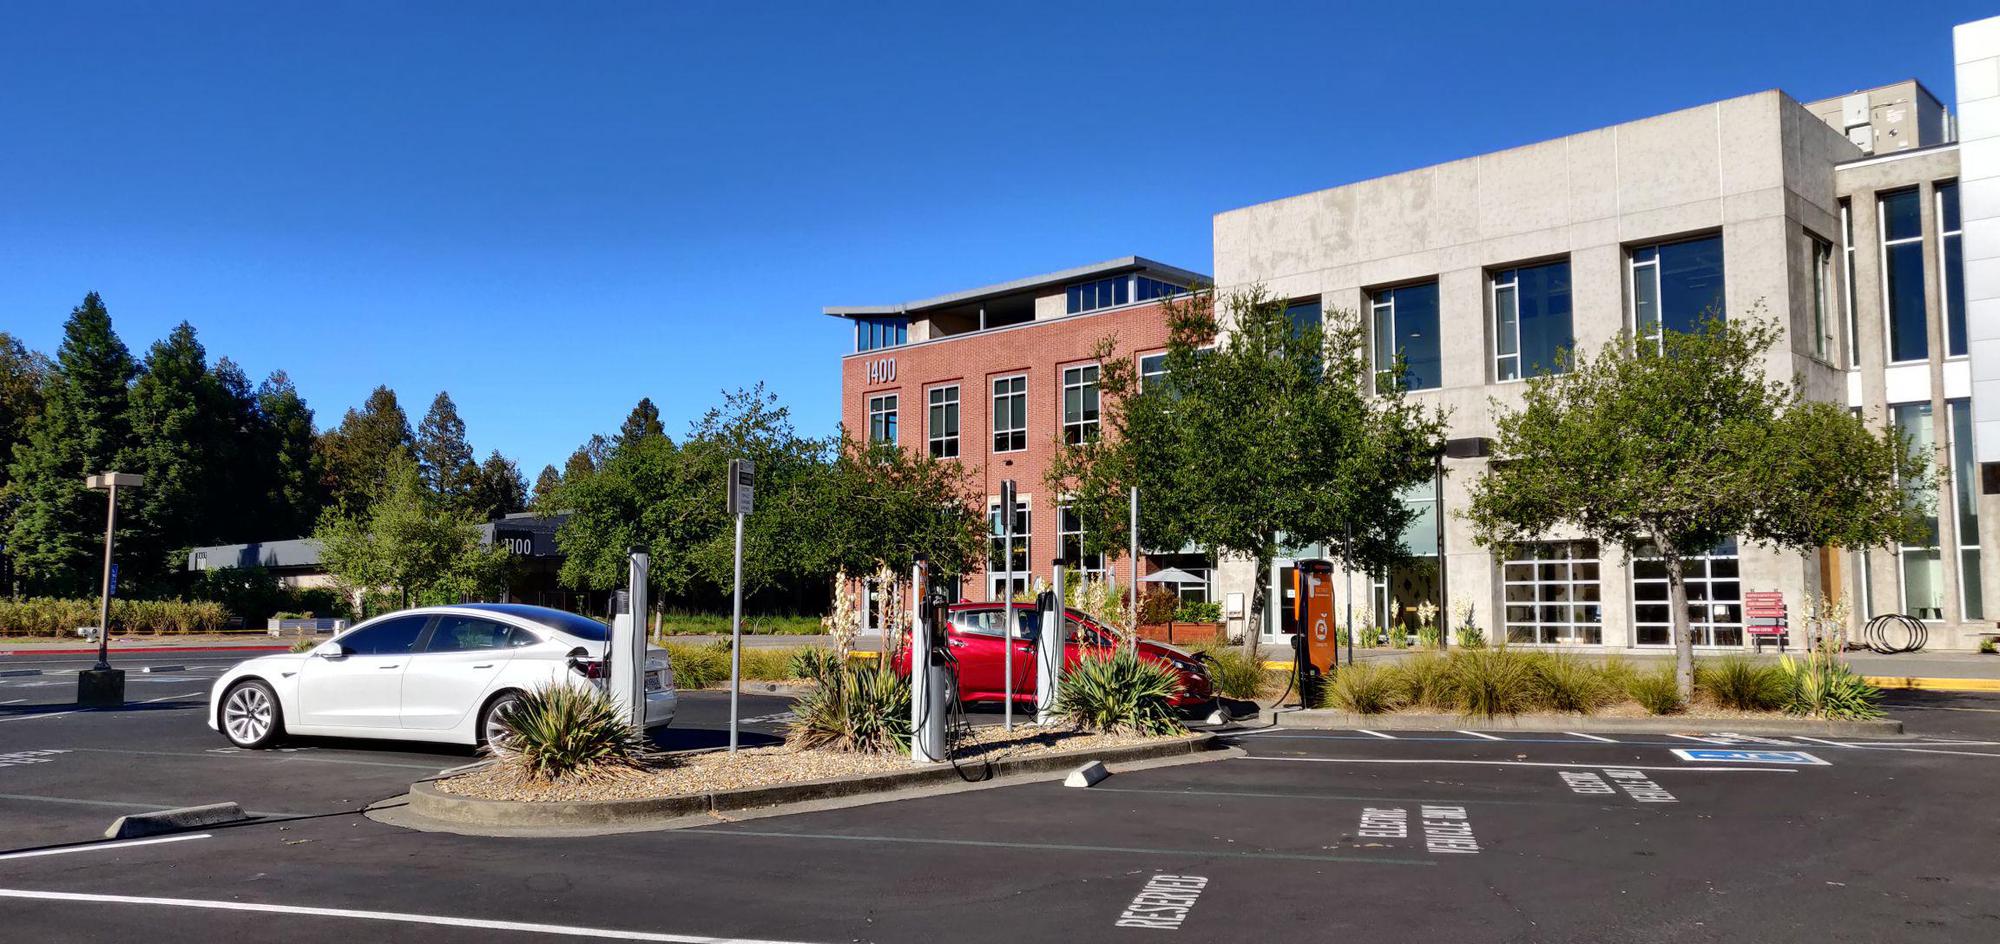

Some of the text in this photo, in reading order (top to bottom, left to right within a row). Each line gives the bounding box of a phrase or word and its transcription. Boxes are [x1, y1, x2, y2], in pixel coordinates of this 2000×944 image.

[866, 358, 896, 385] 1400
[505, 538, 531, 555] 1100
[1359, 807, 1407, 838] ELECTRIC
[1423, 820, 1480, 854] VEHICLE
[1115, 875, 1208, 930] RESERVED
